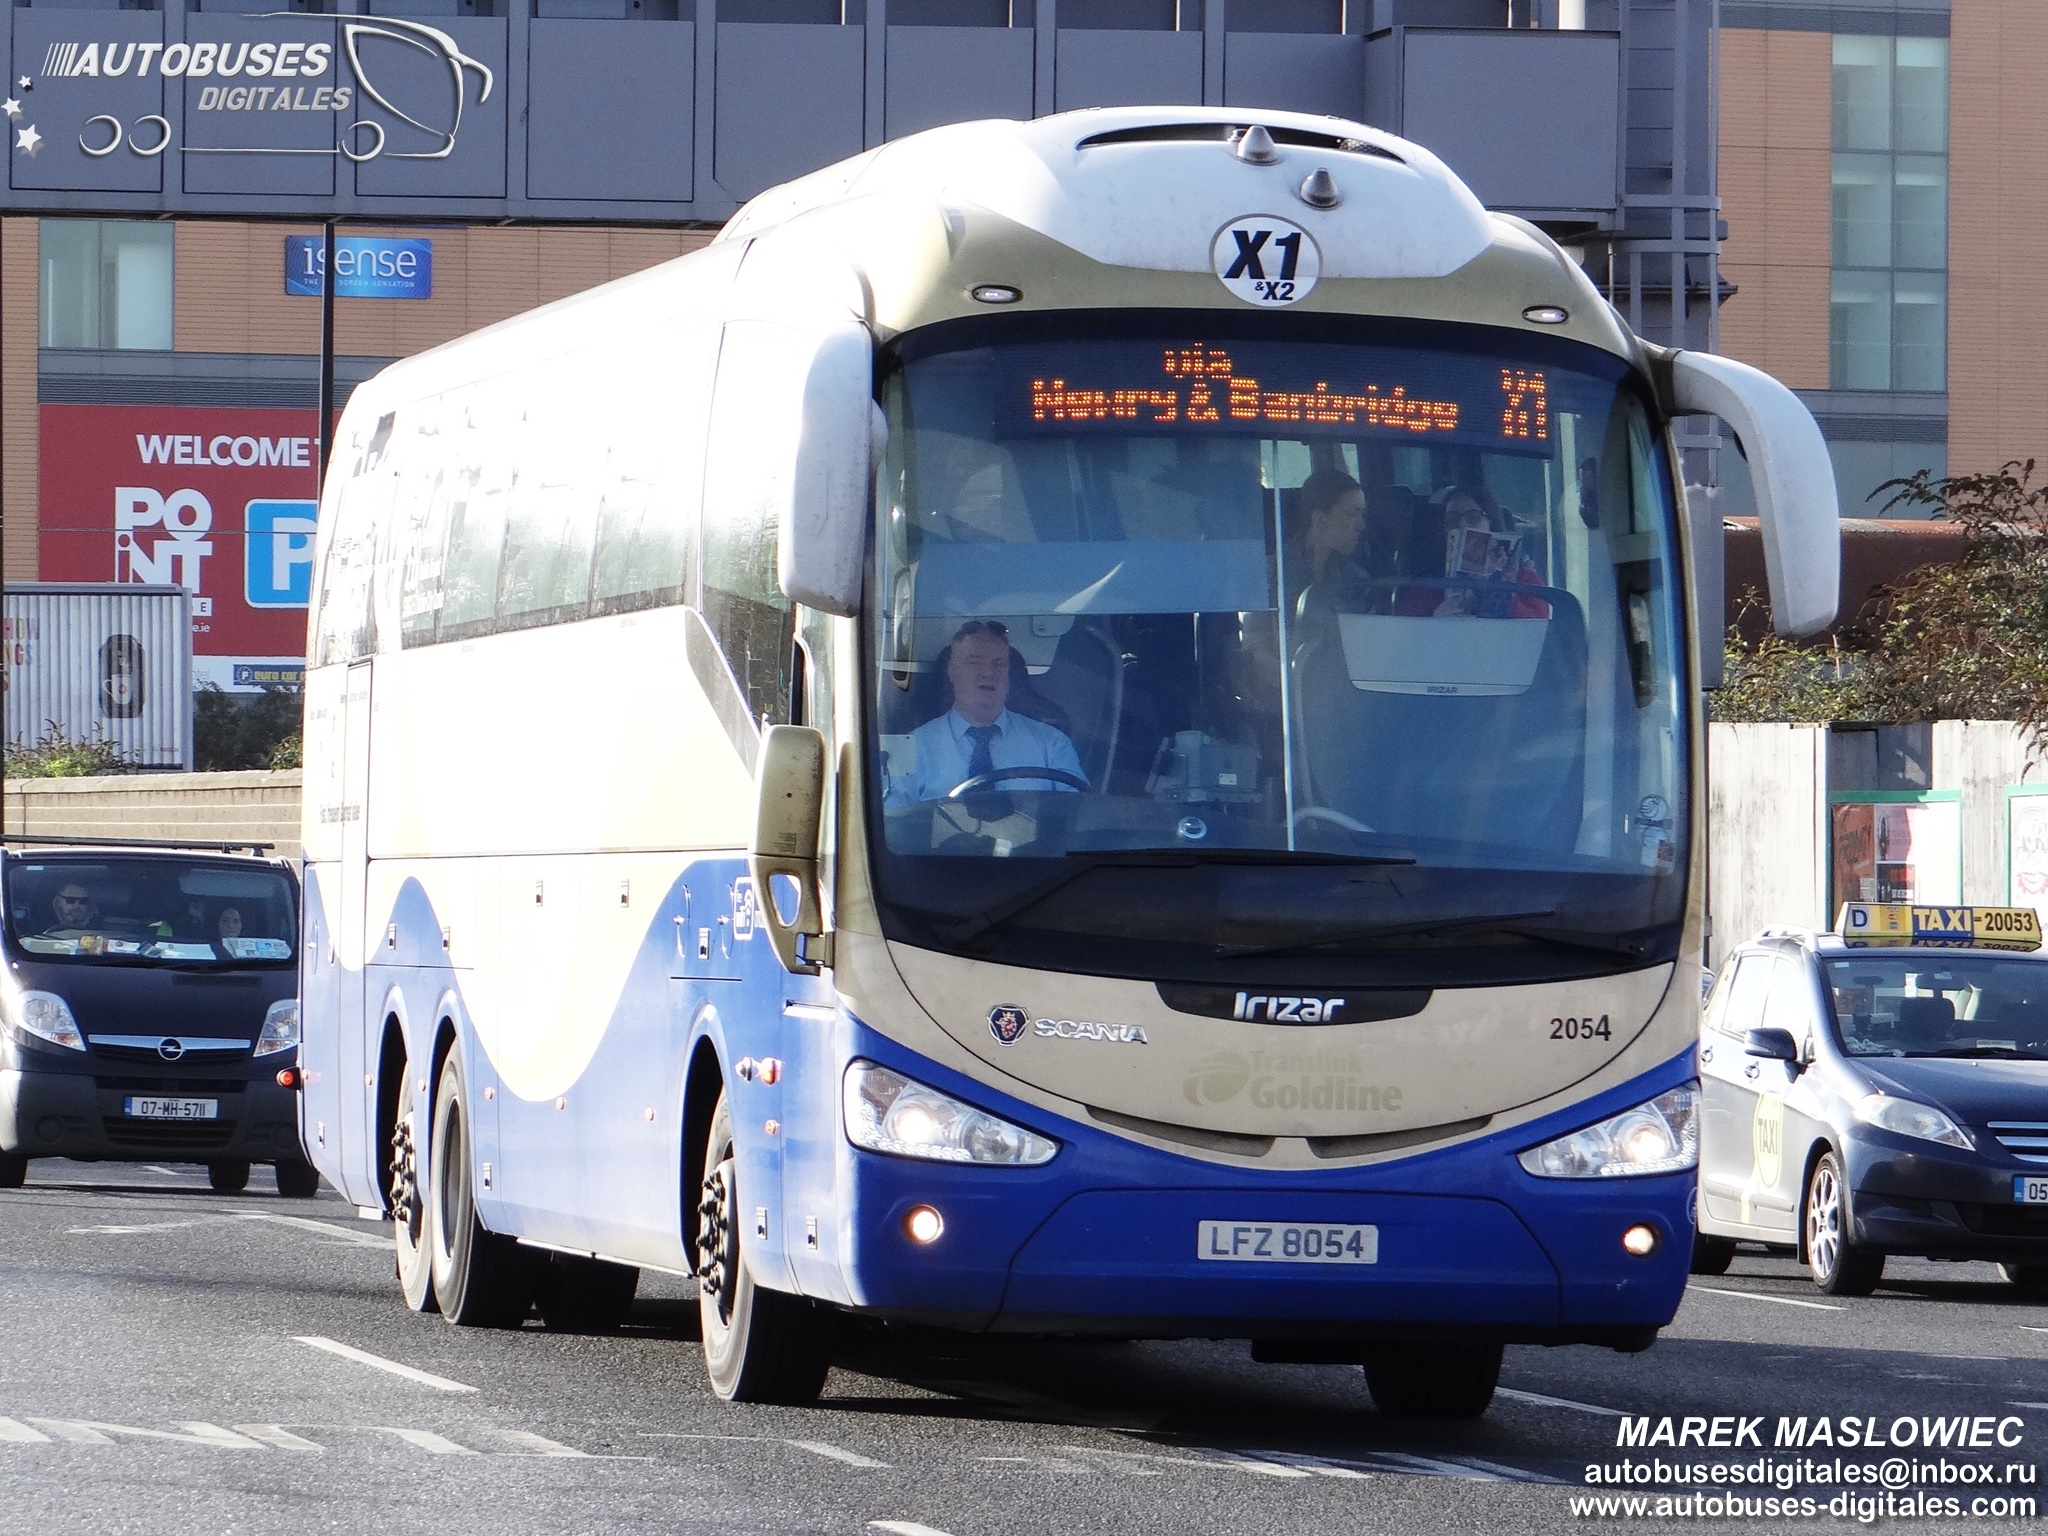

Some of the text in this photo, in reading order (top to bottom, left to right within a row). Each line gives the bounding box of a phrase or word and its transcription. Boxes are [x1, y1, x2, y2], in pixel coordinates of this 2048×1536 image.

[1223, 230, 1302, 281] X1
[1164, 342, 1232, 379] via
[136, 434, 311, 467] WELCOME
[1852, 909, 1869, 928] D
[1912, 908, 2034, 932] TAXI 20053
[1233, 992, 1346, 1022] Irizar
[1033, 1016, 1149, 1045] SCANIA
[1549, 1014, 1612, 1042] 2054
[1250, 1075, 1403, 1112] Goldline
[1757, 1117, 1779, 1155] TAXI
[1211, 1226, 1364, 1259] LFZ 8054
